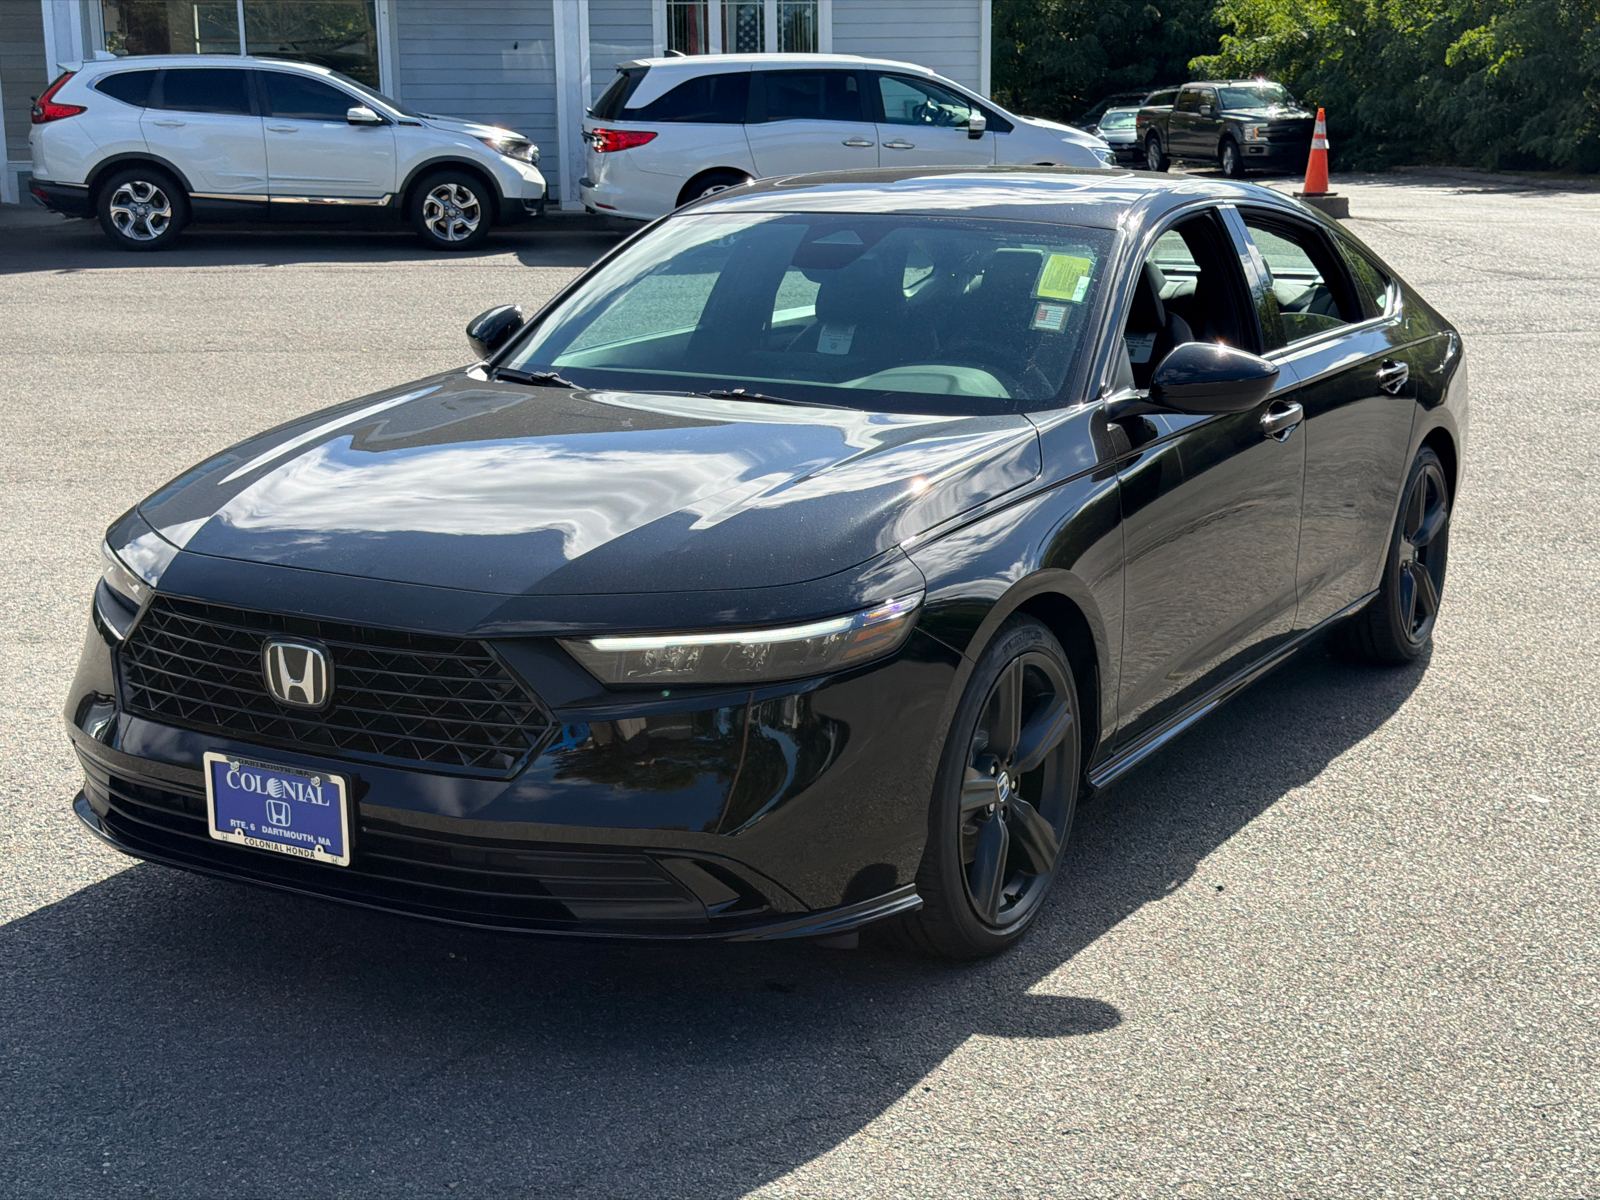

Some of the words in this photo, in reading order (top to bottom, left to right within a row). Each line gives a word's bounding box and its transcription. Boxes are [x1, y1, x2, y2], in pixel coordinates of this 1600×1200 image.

[226, 770, 330, 807] COLONIAL
[230, 818, 249, 830] RTE.
[261, 825, 317, 844] DARTMOUTH,
[318, 836, 332, 847] MA
[243, 837, 284, 853] COLONIAL
[285, 843, 316, 859] HONDA
